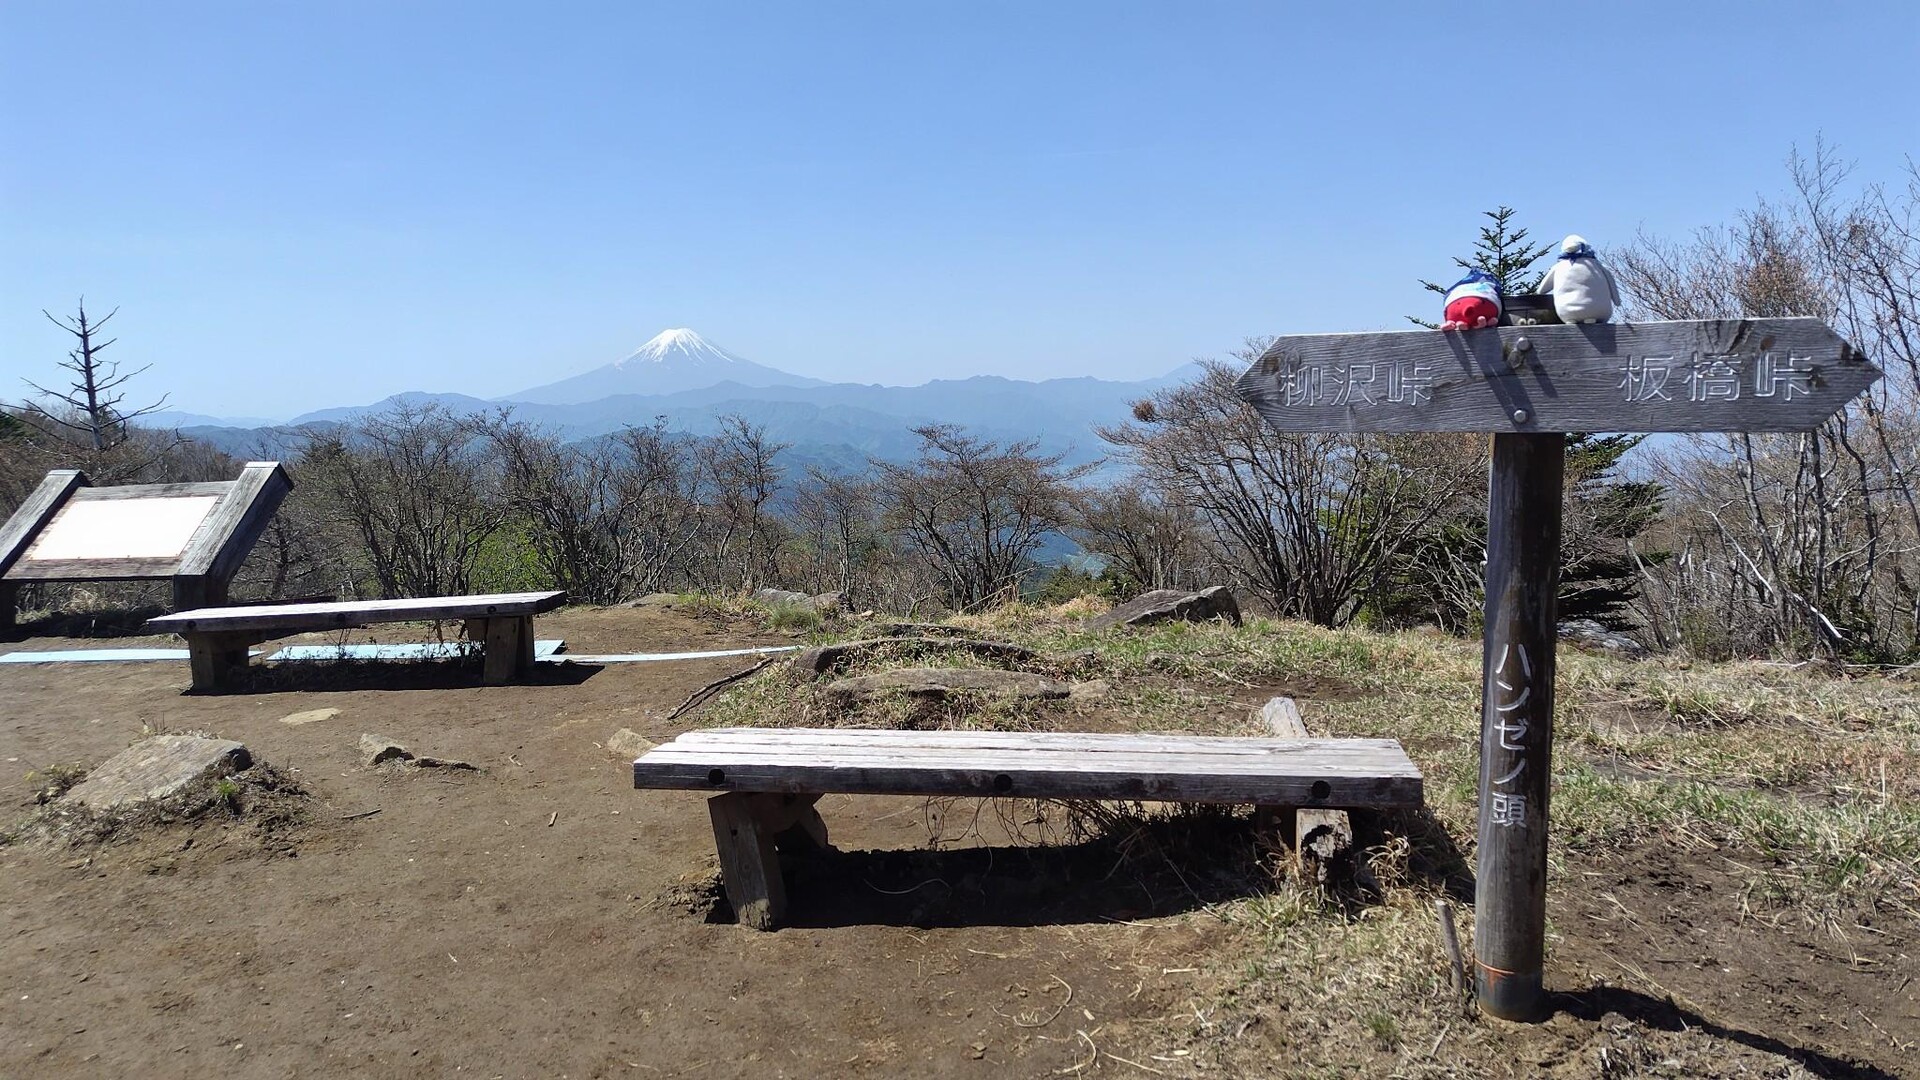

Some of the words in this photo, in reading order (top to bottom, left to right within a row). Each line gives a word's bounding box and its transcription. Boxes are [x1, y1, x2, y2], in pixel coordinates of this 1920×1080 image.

[1279, 361, 1432, 406] 柳沢峠
[1617, 350, 1813, 402] 板橋峠
[1491, 643, 1531, 828] ハンゼノ頭
